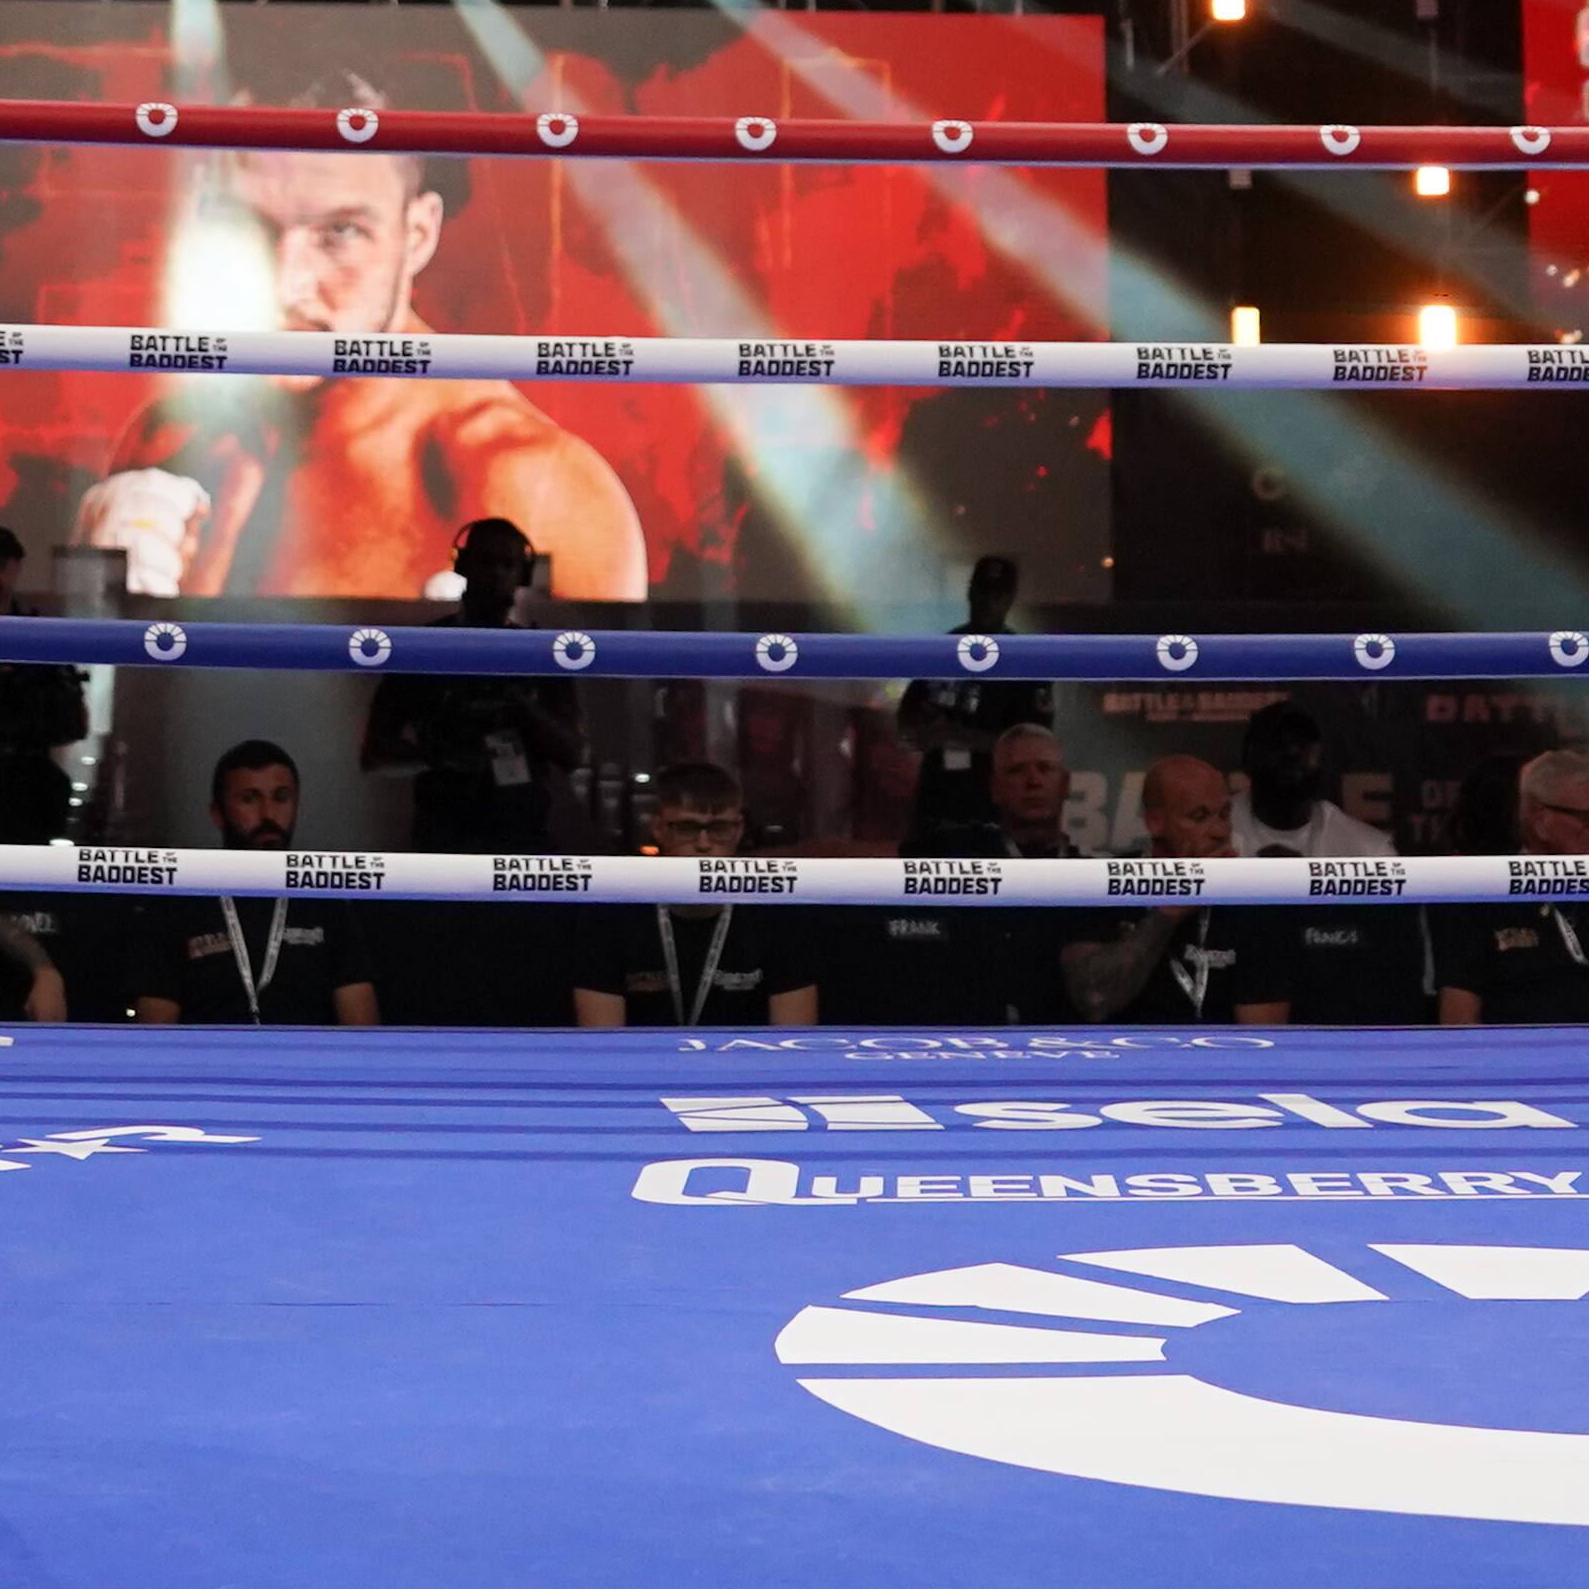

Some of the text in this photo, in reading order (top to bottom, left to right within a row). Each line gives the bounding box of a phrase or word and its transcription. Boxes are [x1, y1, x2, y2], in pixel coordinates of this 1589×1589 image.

[130, 335, 210, 352] BATTLE
[334, 340, 413, 357] BATTLE
[538, 342, 616, 358] BATTLE
[739, 344, 816, 357] BATTLE
[939, 345, 1016, 358] BATTLE
[130, 353, 228, 369] BADDEST
[1137, 347, 1214, 361] BATTLE
[1334, 349, 1409, 363] BATTLE
[1528, 350, 1589, 364] BATTL
[333, 358, 432, 375] BADDEST
[537, 360, 634, 376] BADDEST
[738, 359, 835, 377] BADDEST
[938, 360, 1034, 378] BADDEST
[1137, 362, 1232, 380] BADDEST
[1333, 365, 1427, 382] BADDEST
[1527, 366, 1589, 382] BADDE
[79, 849, 159, 863] BATTLE
[286, 854, 366, 869] BATTLE
[493, 858, 573, 871] BATTLE
[699, 860, 779, 873] BATTLE
[904, 861, 984, 875] BATTLE
[1107, 862, 1186, 876] BATTLE
[1309, 862, 1388, 876] BATTLE
[1508, 861, 1586, 876] BATTLE
[77, 864, 178, 885] BADDEST
[285, 870, 385, 890] BADDEST
[493, 873, 592, 891] BADDEST
[699, 875, 798, 893] BADDEST
[904, 877, 1002, 895] BADDEST
[1108, 878, 1205, 896] BADDEST
[1309, 878, 1407, 896] BADDEST
[1509, 878, 1589, 895] BADDES
[678, 1037, 1010, 1051] JACOB
[951, 1093, 1578, 1130] sela
[631, 1158, 1583, 1206] QUEENSBERRY
